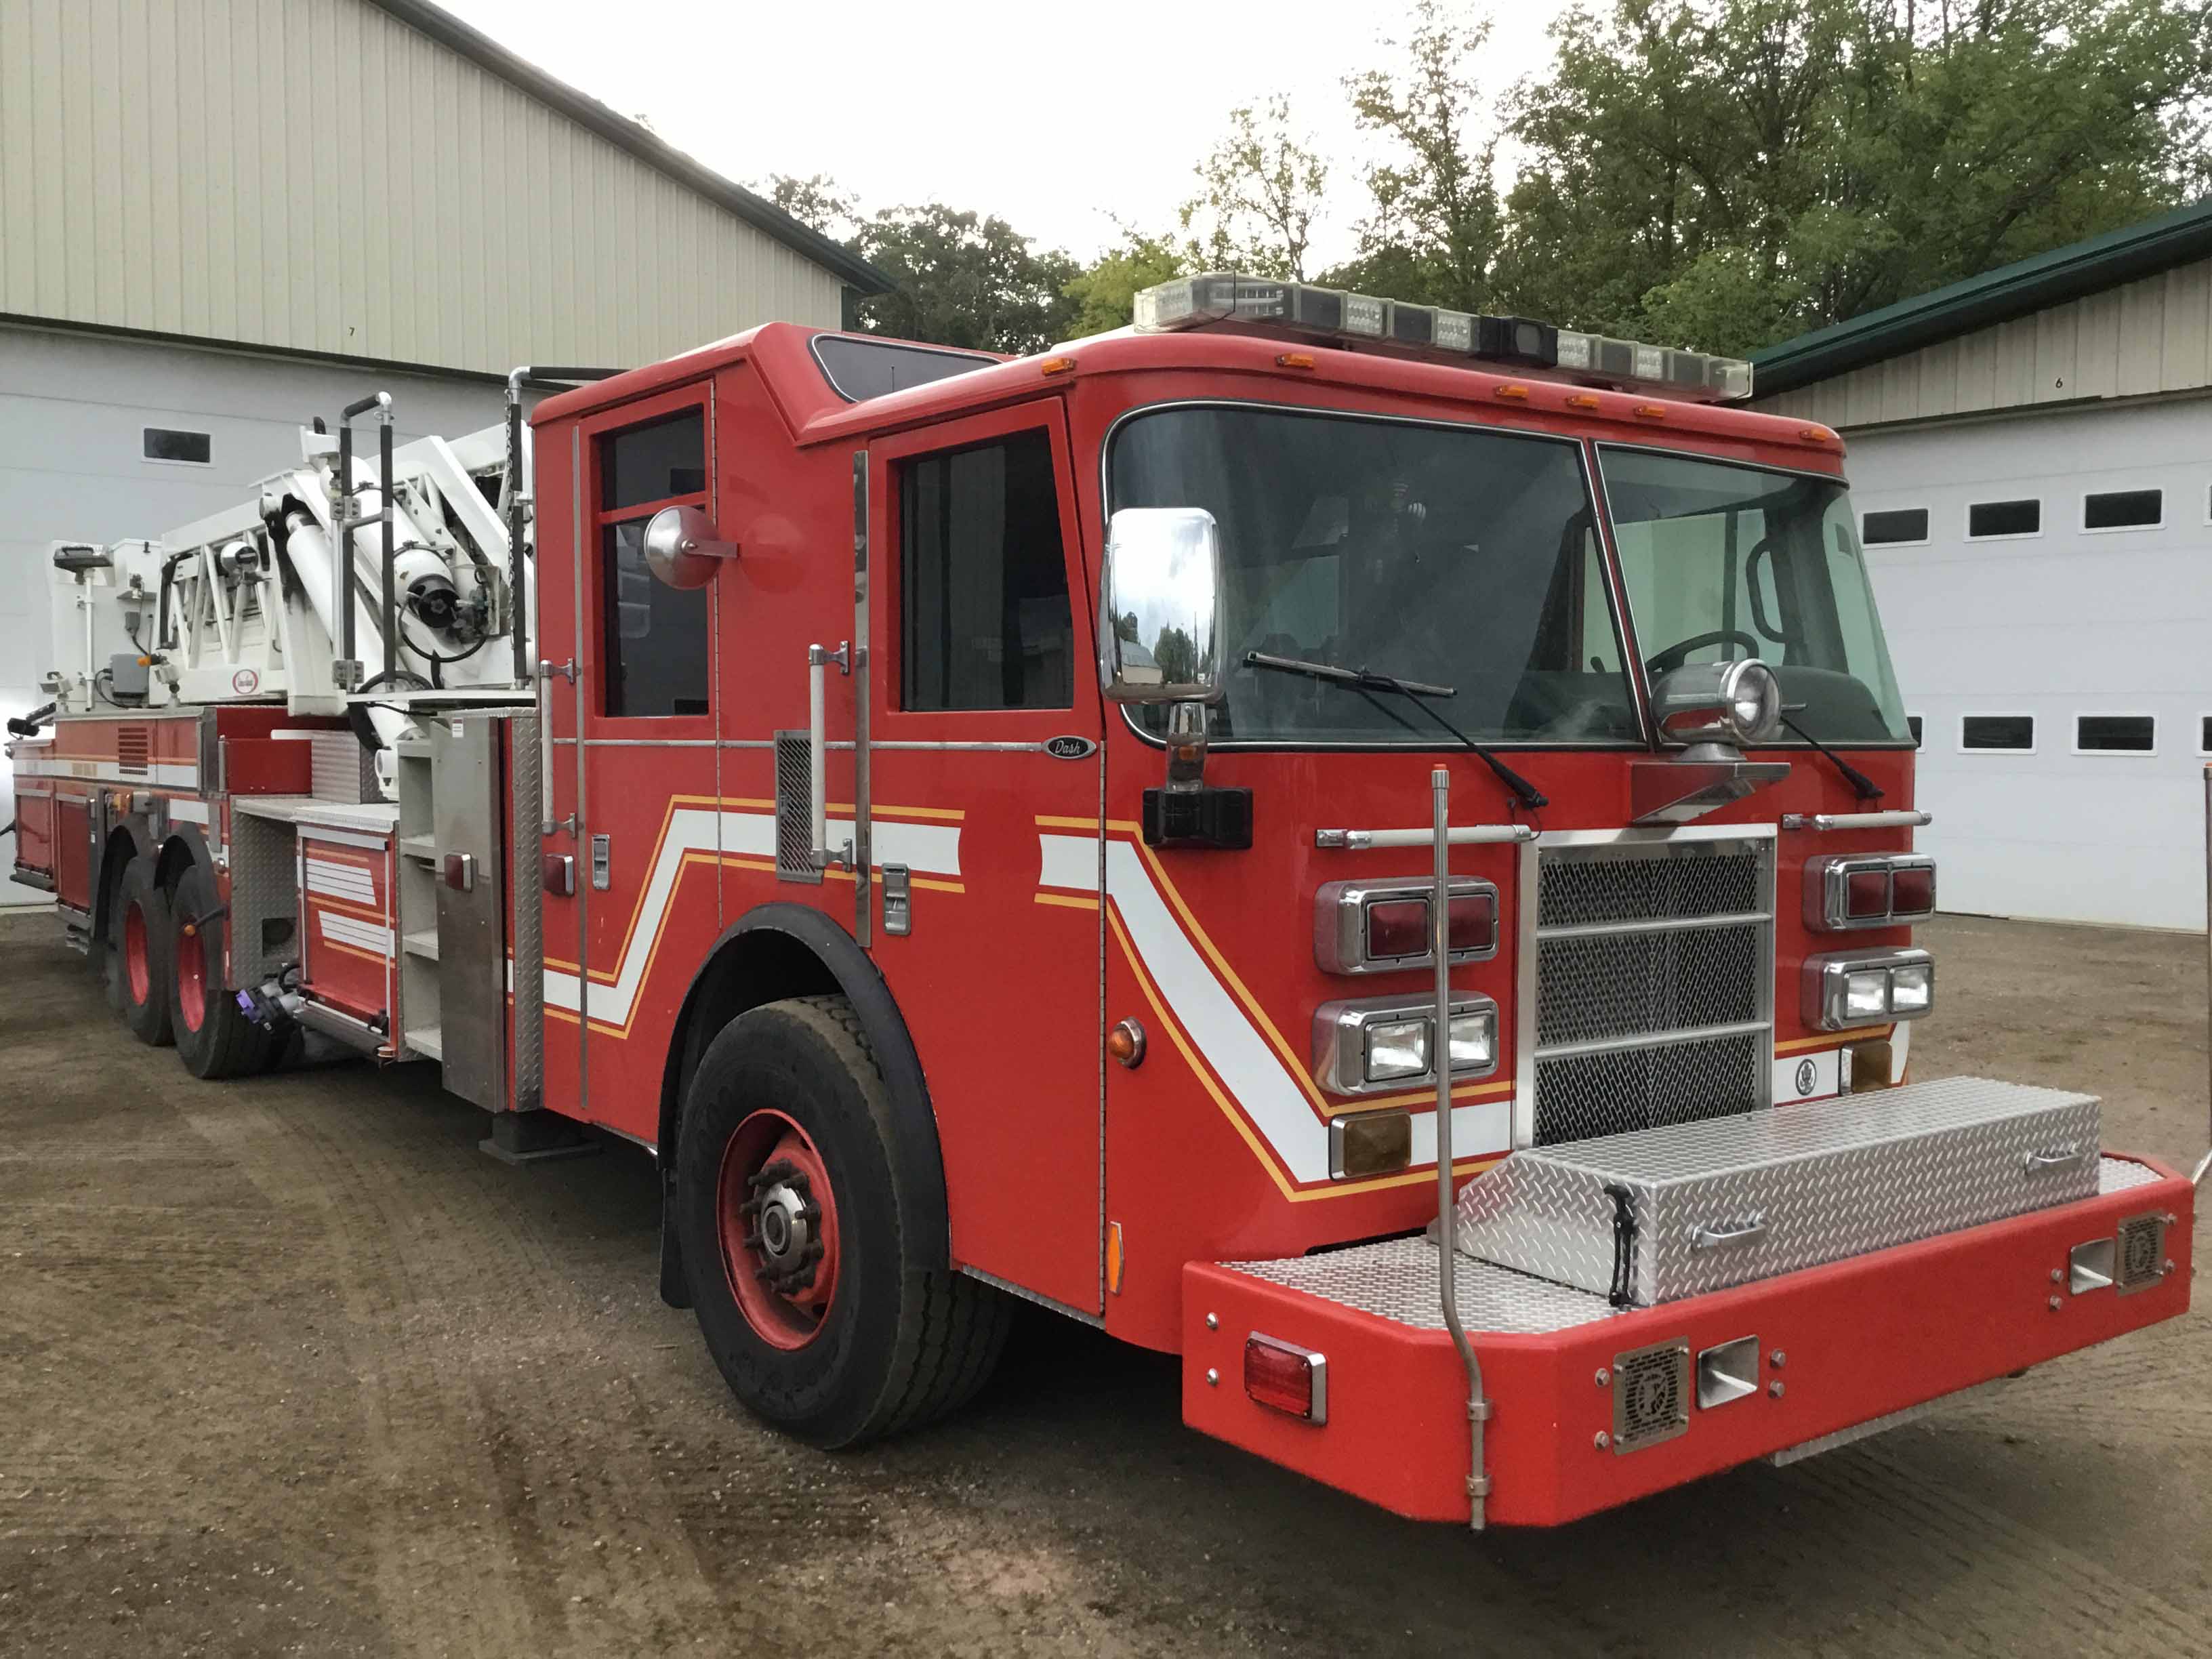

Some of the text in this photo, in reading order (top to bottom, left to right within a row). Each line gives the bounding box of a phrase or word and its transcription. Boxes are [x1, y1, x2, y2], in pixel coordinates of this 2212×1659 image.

[348, 327, 355, 337] 7
[2055, 377, 2063, 388] 6
[1054, 739, 1080, 754] Dash
